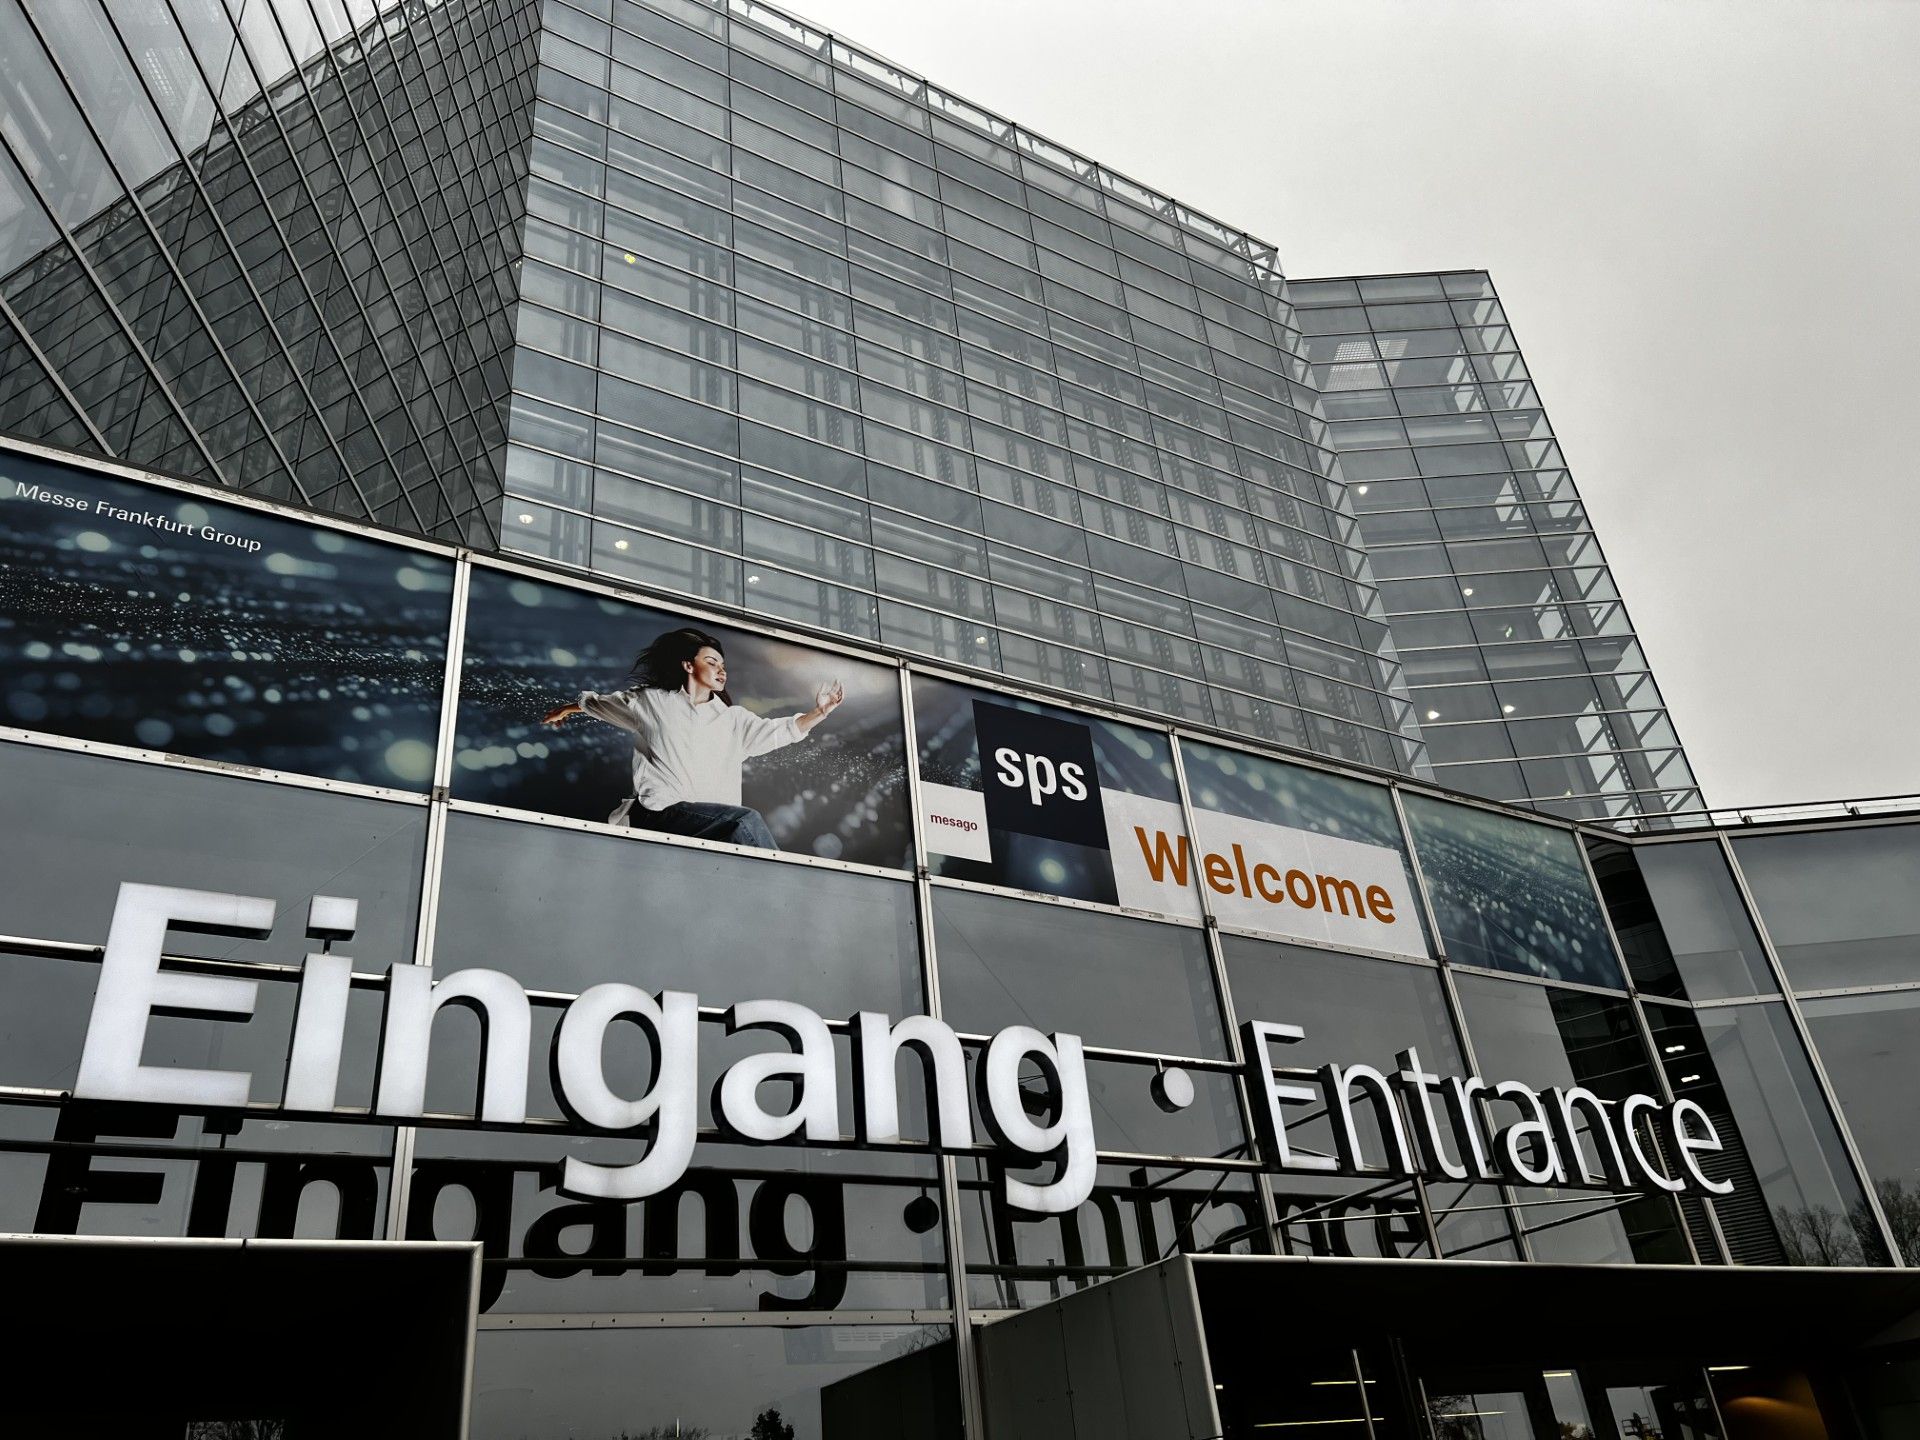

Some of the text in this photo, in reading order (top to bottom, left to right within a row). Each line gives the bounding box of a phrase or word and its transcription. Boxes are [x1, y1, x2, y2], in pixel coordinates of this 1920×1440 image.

[15, 481, 262, 553] Messe Frankfurt Group
[994, 746, 1088, 806] sps
[930, 814, 978, 832] mesago
[1135, 825, 1395, 924] Welcome
[73, 881, 1098, 1213] Eingang
[1243, 1019, 1736, 1195] Entrance
